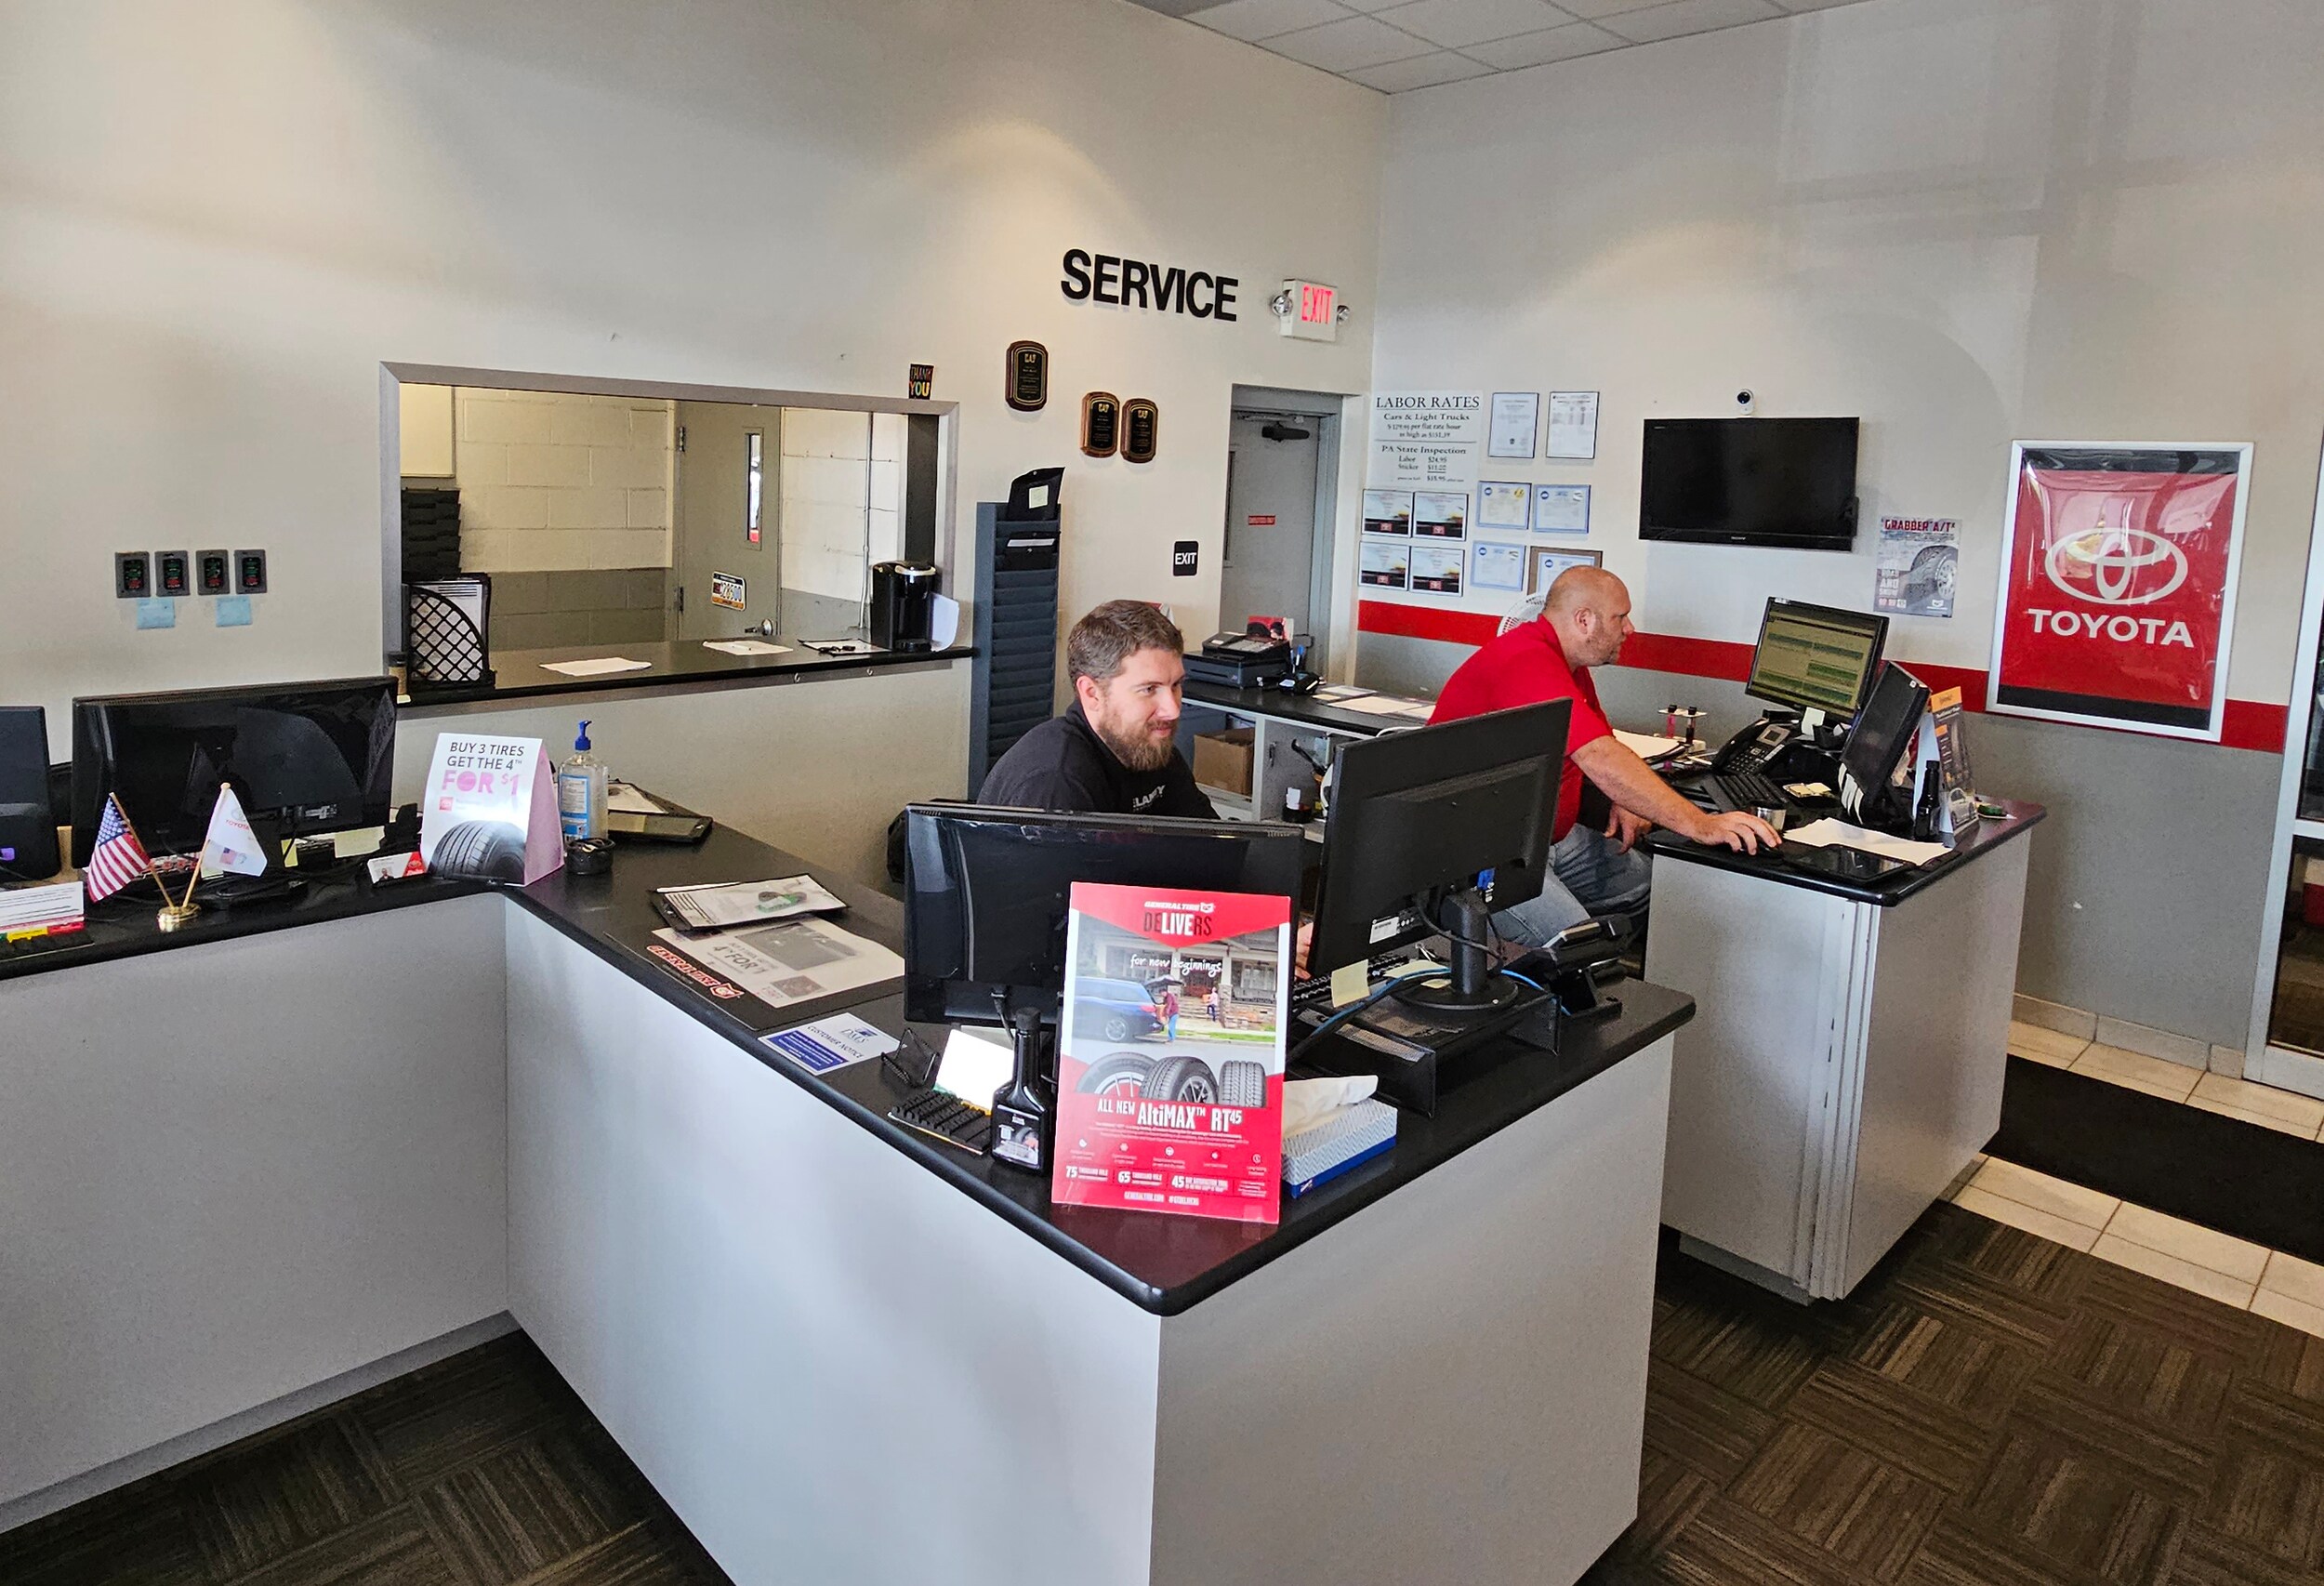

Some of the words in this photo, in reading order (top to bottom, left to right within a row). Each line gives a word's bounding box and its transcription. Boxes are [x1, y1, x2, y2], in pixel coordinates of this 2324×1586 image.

[1061, 248, 1238, 322] SERVICE
[1301, 284, 1333, 324] EXIT
[909, 381, 930, 397] YOU
[1376, 396, 1427, 408] LABOR
[1431, 396, 1480, 408] RATES
[1414, 413, 1437, 421] Light
[1420, 446, 1467, 455] Inspection
[1884, 519, 1930, 532] GRABBER
[1175, 552, 1197, 565] EXIT
[2027, 608, 2194, 649] TOYOTA
[450, 742, 477, 753] BUY
[478, 744, 486, 754] 3
[490, 745, 525, 757] TIRES
[447, 756, 474, 768] GET
[478, 757, 503, 770] THE
[442, 770, 495, 794] FOR
[501, 773, 520, 796] $1
[226, 819, 250, 830] TOYOTA
[1143, 912, 1212, 936] DELIVERS
[646, 945, 697, 973] GENERAL
[1130, 954, 1146, 969] for
[1149, 958, 1170, 968] new
[1173, 958, 1222, 978] beginnings
[807, 1025, 840, 1046] CUSTOMER
[839, 1043, 865, 1059] NOTICE
[1097, 1098, 1113, 1113] ALL
[1116, 1100, 1135, 1116] NEW
[1065, 1165, 1077, 1179] 75
[1117, 1170, 1131, 1183] 65
[1171, 1175, 1185, 1188] 45
